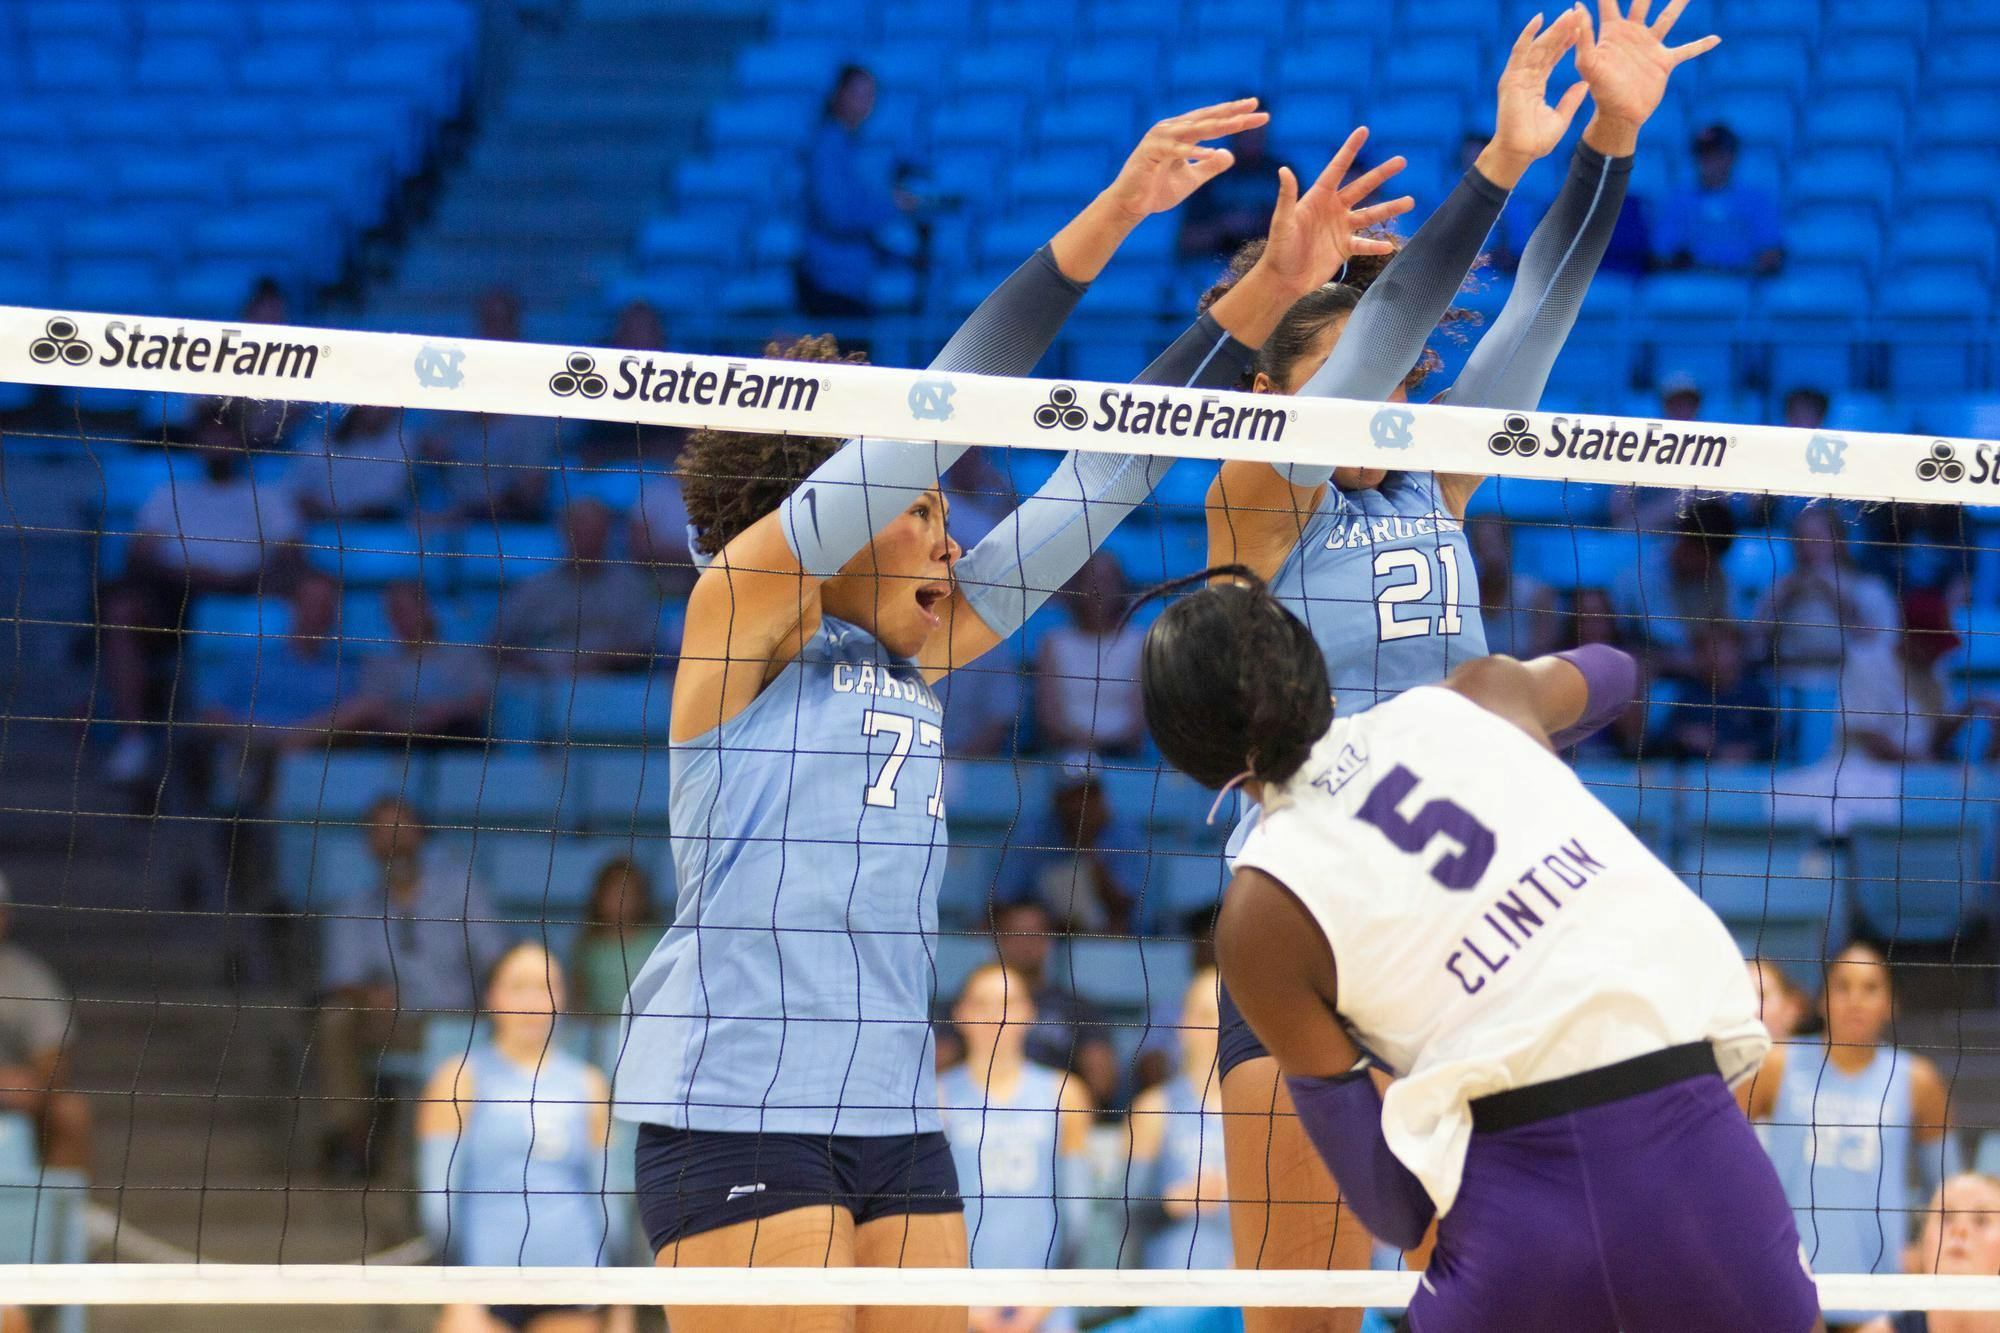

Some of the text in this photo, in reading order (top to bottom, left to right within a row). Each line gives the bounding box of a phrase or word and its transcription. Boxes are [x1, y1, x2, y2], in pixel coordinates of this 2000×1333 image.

[1371, 543, 1463, 643] 21
[1352, 761, 1497, 893] 5
[1444, 837, 1607, 995] CLINTON
